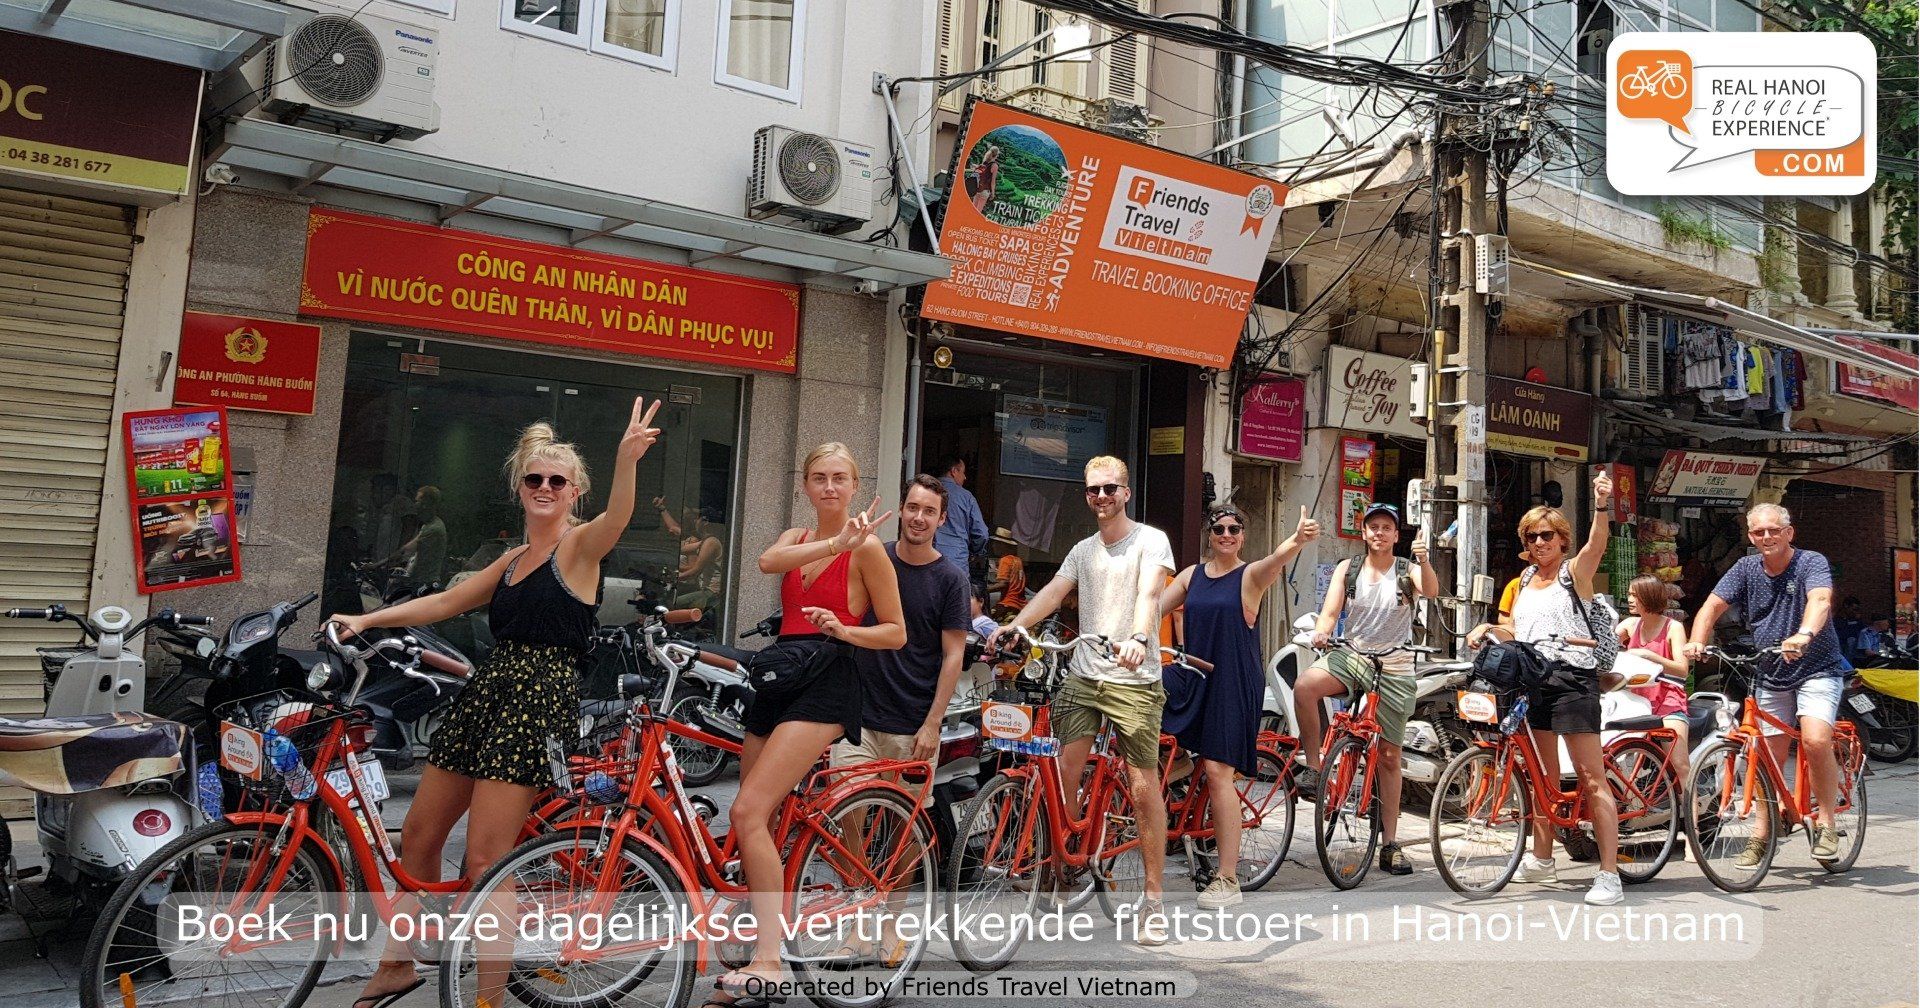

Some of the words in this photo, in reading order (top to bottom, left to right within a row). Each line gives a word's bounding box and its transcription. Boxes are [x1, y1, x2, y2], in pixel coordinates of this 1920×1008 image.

[395, 29, 433, 45] Panasonic
[8, 148, 28, 161] 04
[30, 151, 50, 165] 38
[52, 155, 80, 170] 281
[84, 160, 112, 175] 677
[844, 146, 871, 159] Panasonic
[1022, 194, 1068, 213] TREKKING
[1129, 178, 1210, 216] Friends
[992, 201, 1022, 218] TRAIN
[1025, 209, 1064, 227] TICKETS
[1049, 155, 1101, 290] ADVENTURE
[1124, 205, 1180, 237] Travel
[1022, 221, 1048, 234] INFO
[952, 241, 983, 256] HALONG
[982, 247, 998, 259] BAY
[997, 250, 1027, 265] CRUISES
[998, 234, 1031, 253] SAPA
[1034, 228, 1060, 285] EXPERIENCES
[1117, 230, 1211, 264] Vietnam
[973, 259, 1023, 280] CLIMBING
[1022, 241, 1044, 283] BIKING
[457, 249, 527, 283] CÔNG
[533, 265, 567, 289] AN
[572, 269, 636, 298] NHÂN
[642, 277, 688, 307] DÂN
[956, 271, 1011, 292] EXPEDITIONS
[1091, 260, 1140, 290] TRAVEL
[1142, 272, 1203, 302] BOOKING
[1203, 284, 1251, 312] OFFICE
[976, 289, 1008, 302] TOURS
[1028, 289, 1043, 308] REAL
[336, 266, 365, 297] VÌ
[370, 270, 445, 307] NƯỚC
[450, 286, 520, 317] QUÊN
[525, 296, 594, 330] THÂN,
[600, 302, 623, 331] VÌ
[627, 308, 674, 338] DÂN
[680, 319, 737, 352] PHỤC
[740, 328, 775, 356] VỤ!
[967, 311, 987, 321] STREET
[991, 315, 1013, 326] HOTLINE
[199, 370, 213, 381] AN
[257, 375, 283, 388] HÀNG
[1344, 357, 1397, 396] Coffee
[1363, 393, 1399, 424] Joy
[1490, 400, 1520, 426] LÂM
[1522, 408, 1561, 432] OANH
[990, 718, 1012, 727] Around
